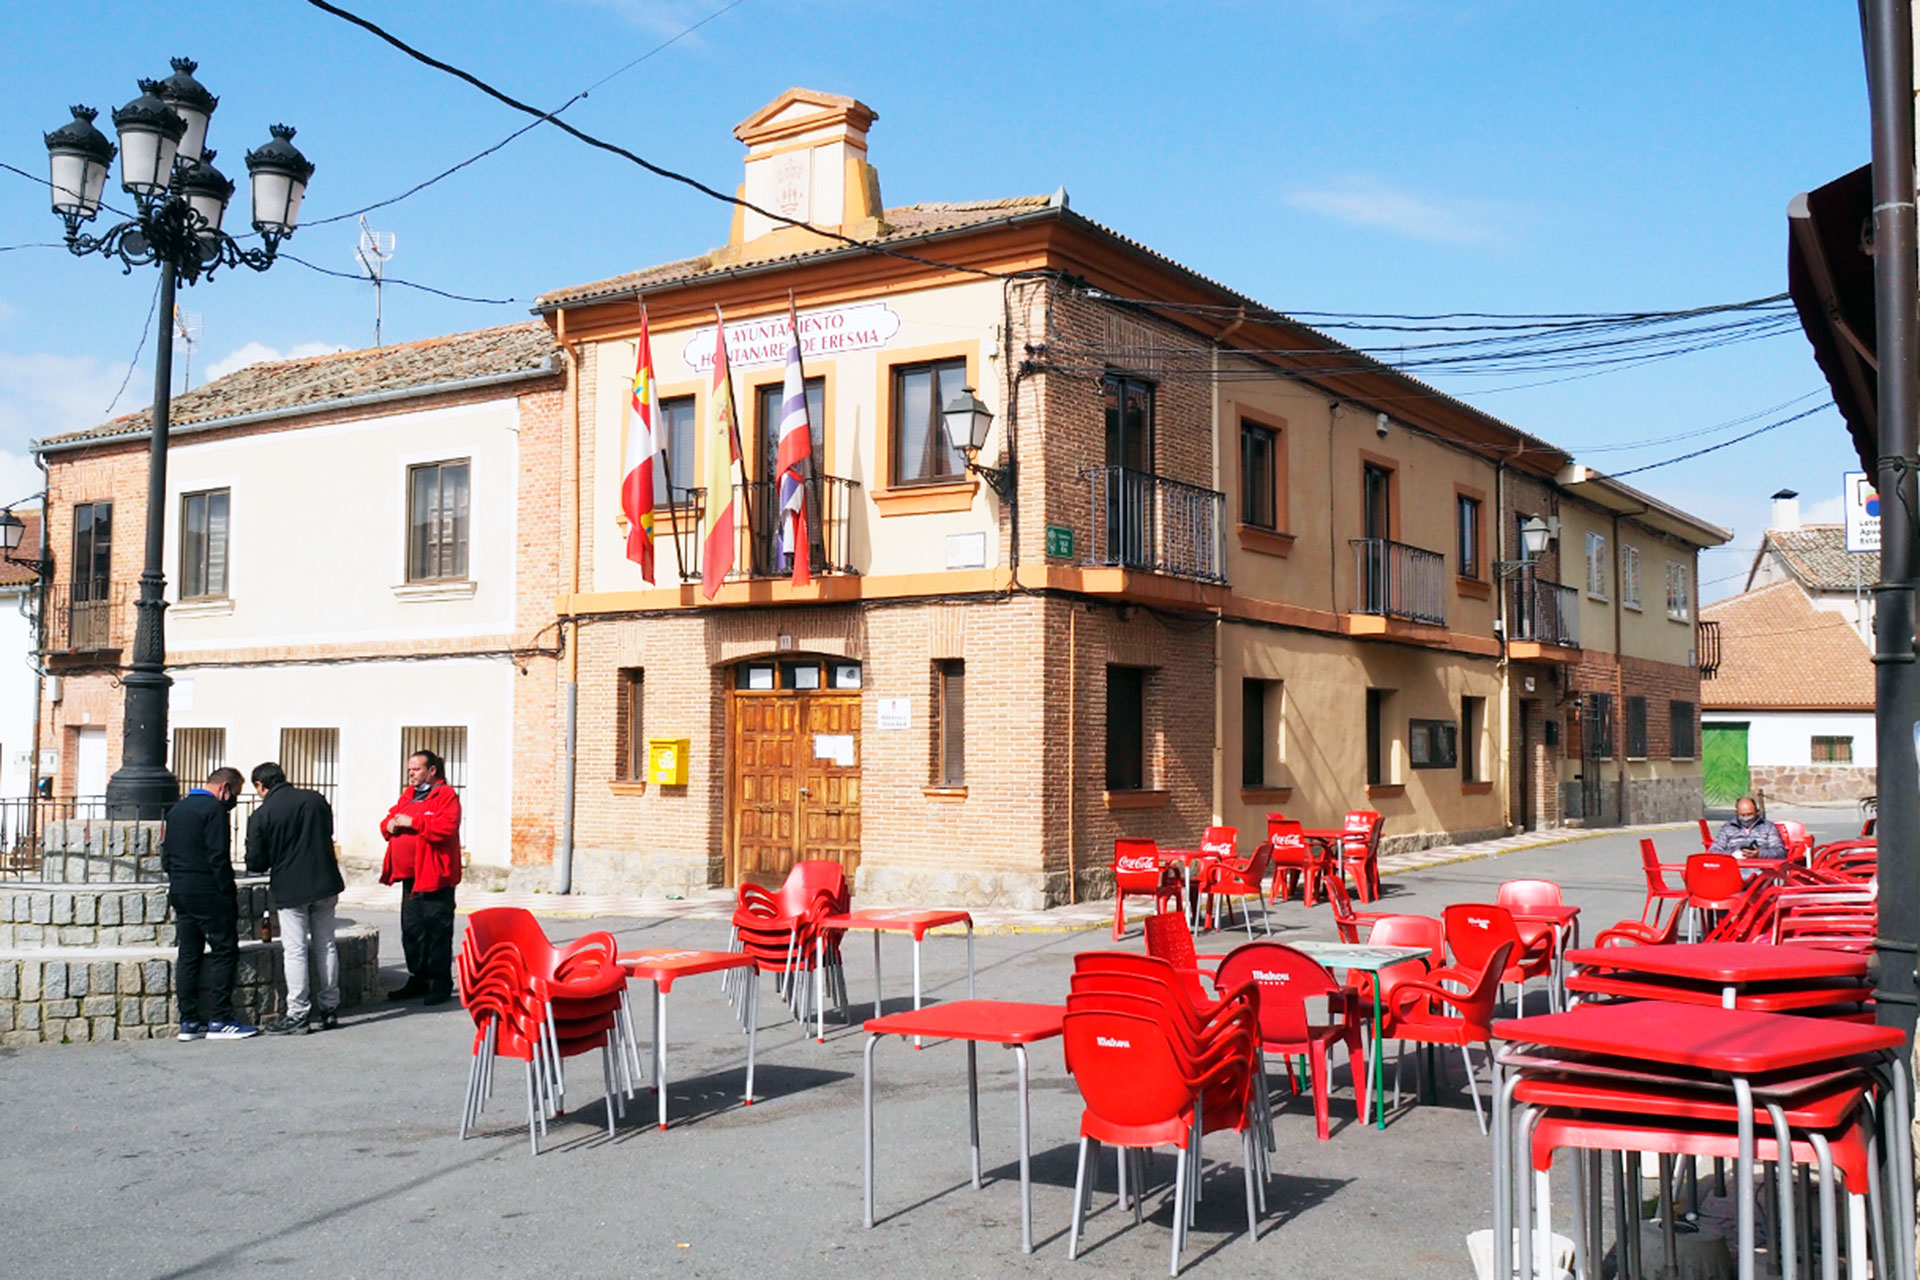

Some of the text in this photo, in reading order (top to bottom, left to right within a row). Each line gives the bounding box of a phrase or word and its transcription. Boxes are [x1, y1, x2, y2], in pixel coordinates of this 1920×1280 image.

[701, 329, 879, 367] HNTANARE DE ERESMA
[1118, 855, 1155, 869] Coca-Cola
[1251, 969, 1290, 981] Mahou
[1096, 1036, 1131, 1048] Mahou
